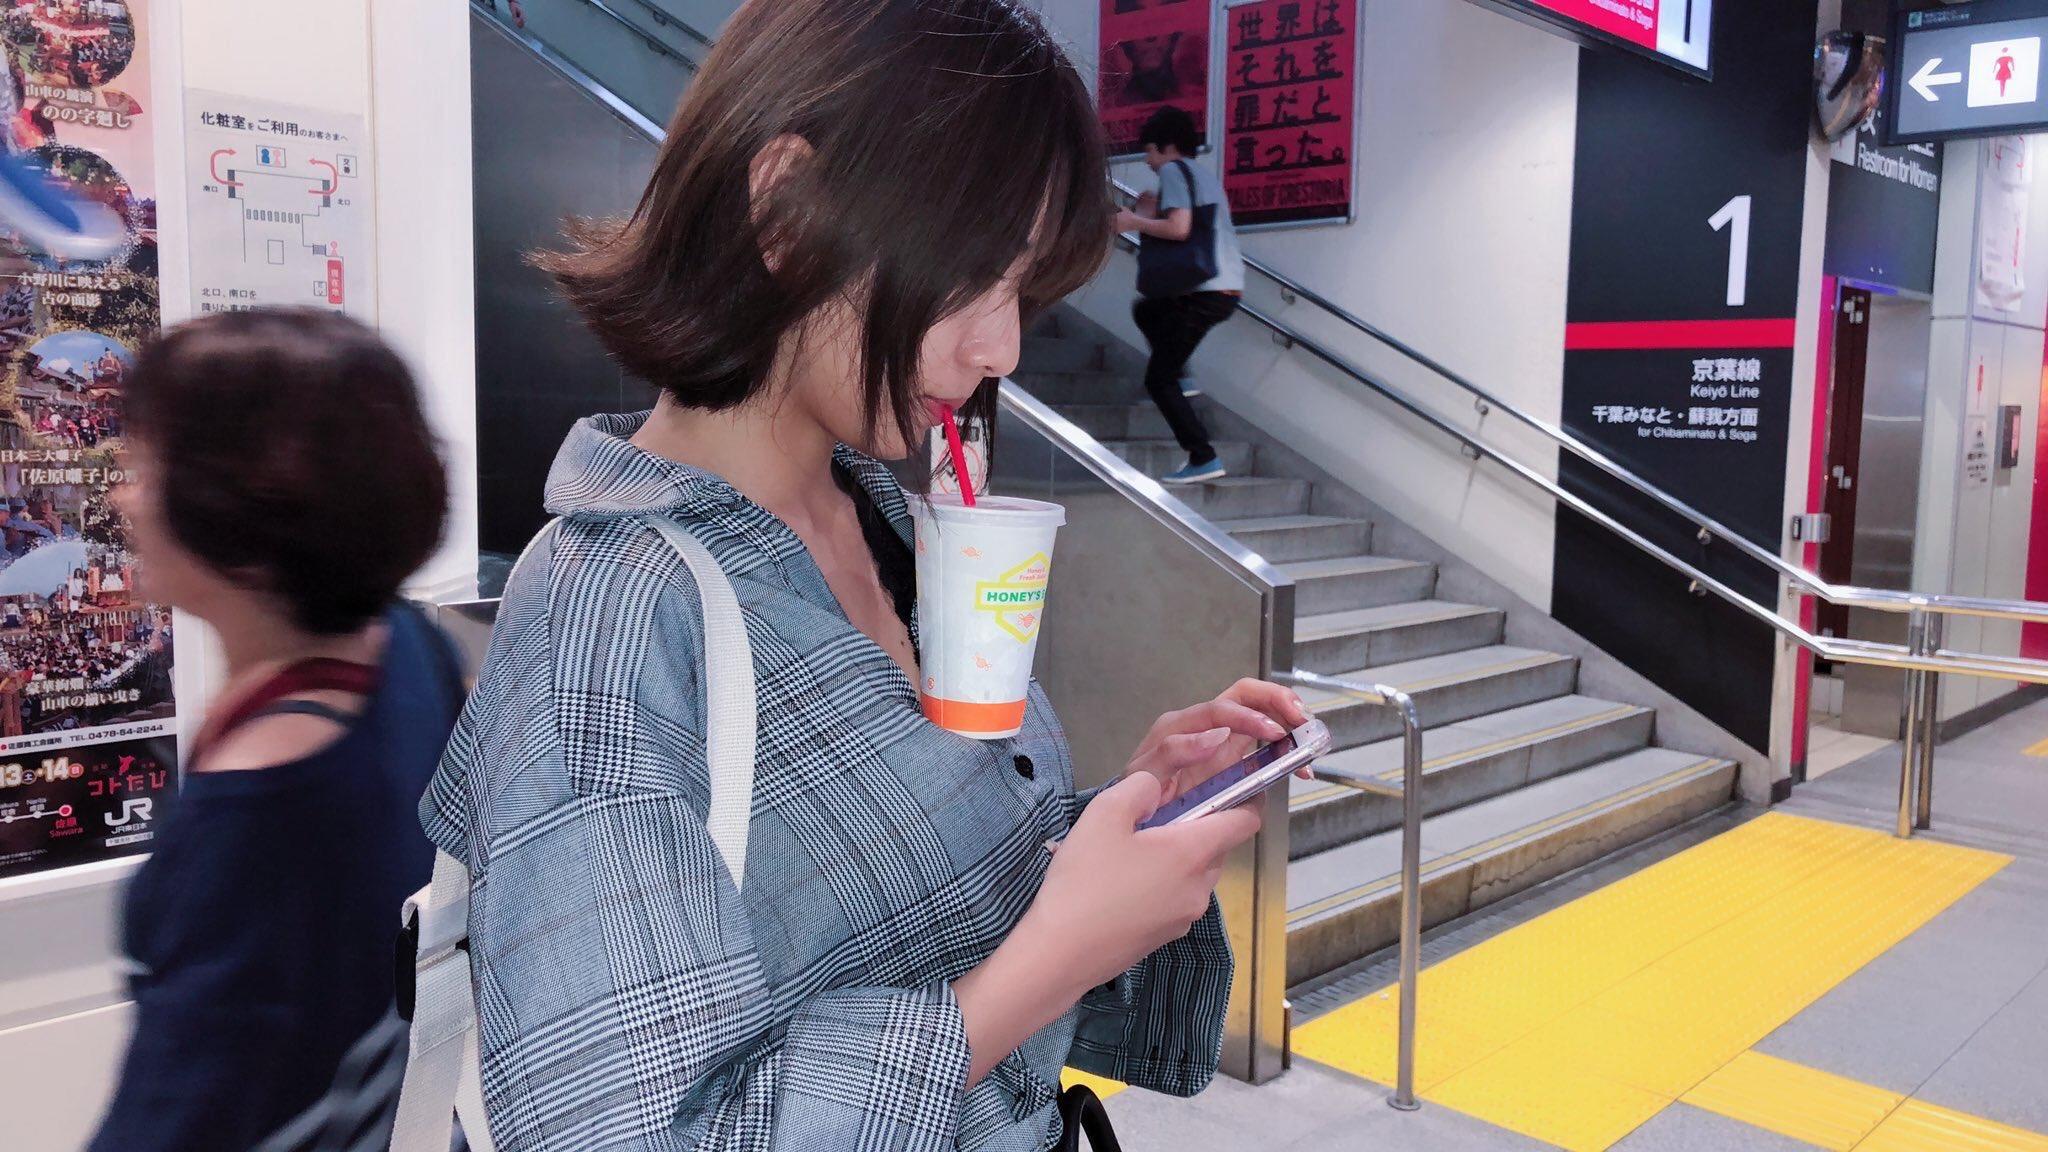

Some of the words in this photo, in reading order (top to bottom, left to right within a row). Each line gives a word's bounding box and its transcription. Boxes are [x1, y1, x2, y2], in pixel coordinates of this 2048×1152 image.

[1236, 0, 1345, 47] 世界は
[1236, 41, 1344, 90] それを
[1234, 85, 1341, 132] 罪だと
[201, 111, 349, 142] 化粧室をご利用のお客さまへ
[1234, 130, 1344, 175] 言った。
[1707, 195, 1751, 307] 1
[1692, 357, 1761, 382] 京葉線
[1731, 385, 1760, 399] Line
[1637, 426, 1650, 438] for
[1653, 426, 1716, 440] Chibaminato
[1718, 430, 1727, 440] &
[1730, 429, 1758, 444] Soga
[986, 590, 1041, 602] HONEY'S
[104, 797, 153, 827] JR
